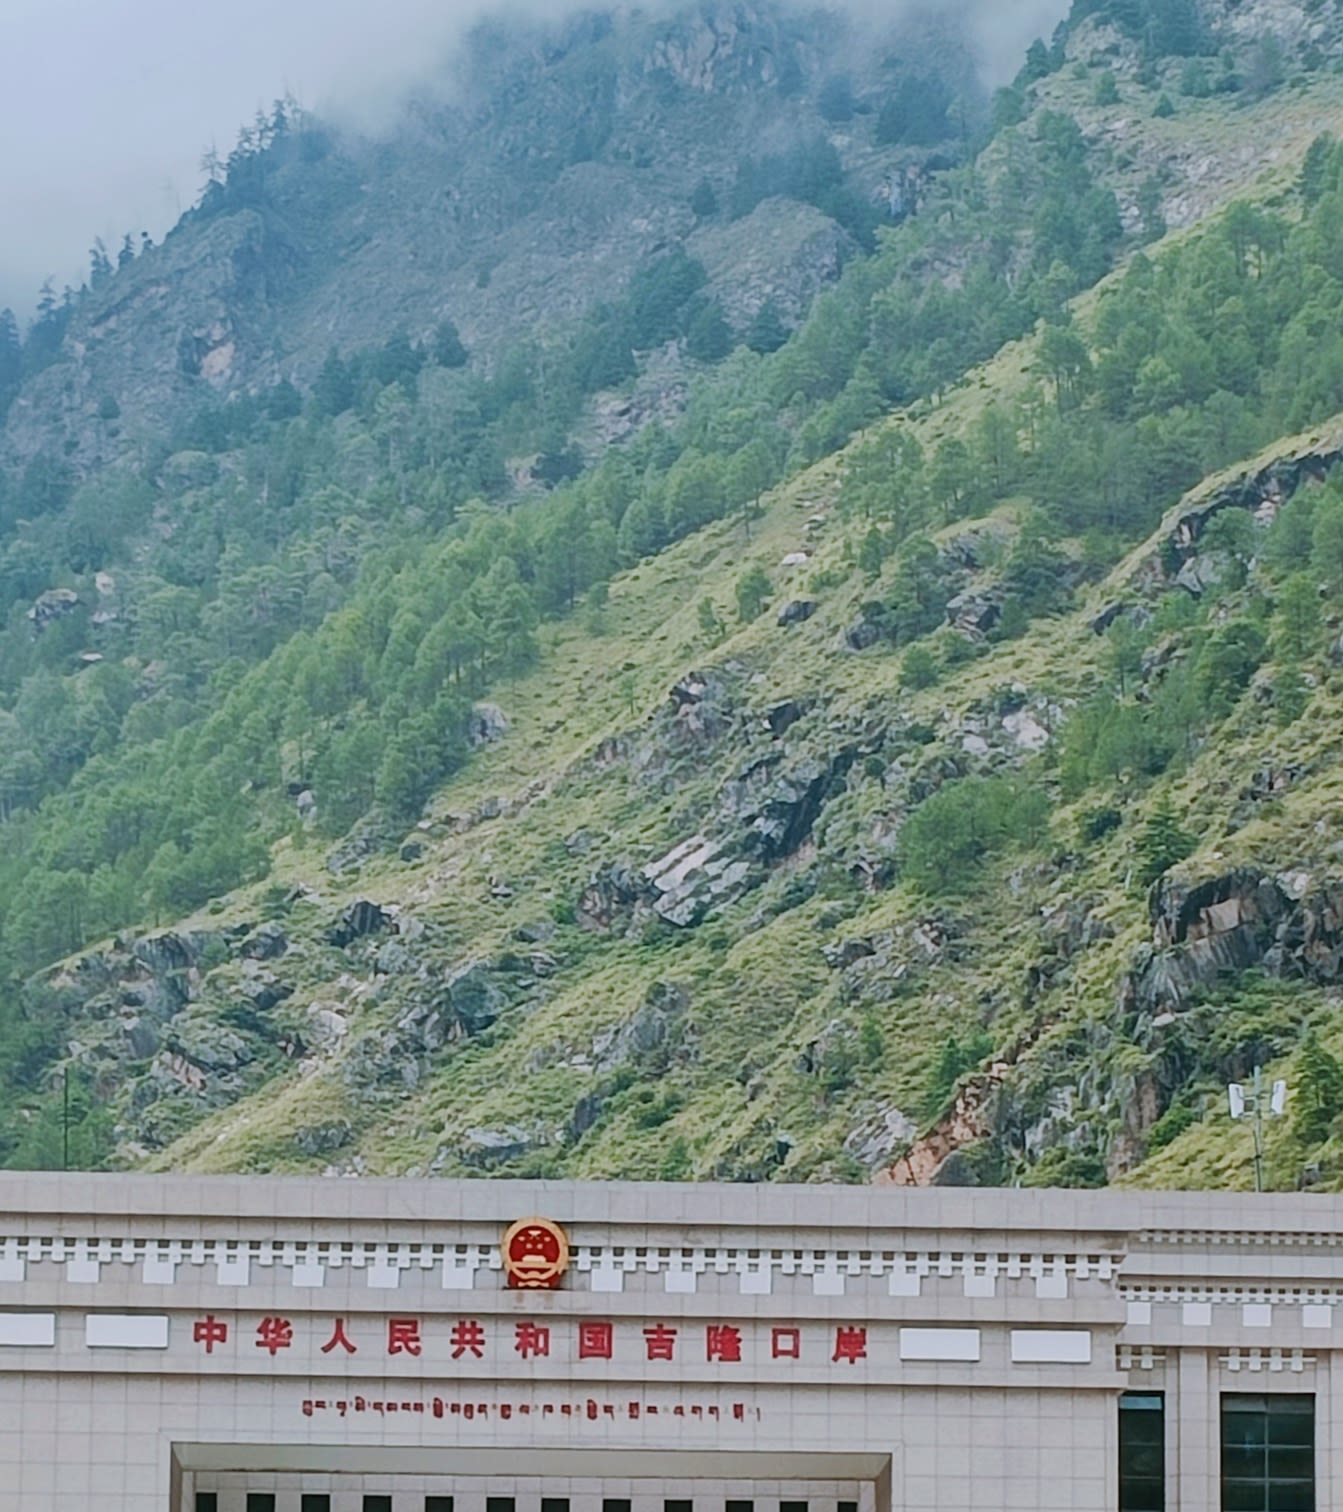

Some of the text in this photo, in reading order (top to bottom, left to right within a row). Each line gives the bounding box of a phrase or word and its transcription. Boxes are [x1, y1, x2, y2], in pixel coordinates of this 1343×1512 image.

[193, 1315, 868, 1364] 中华人民共和国吉隆口岸
